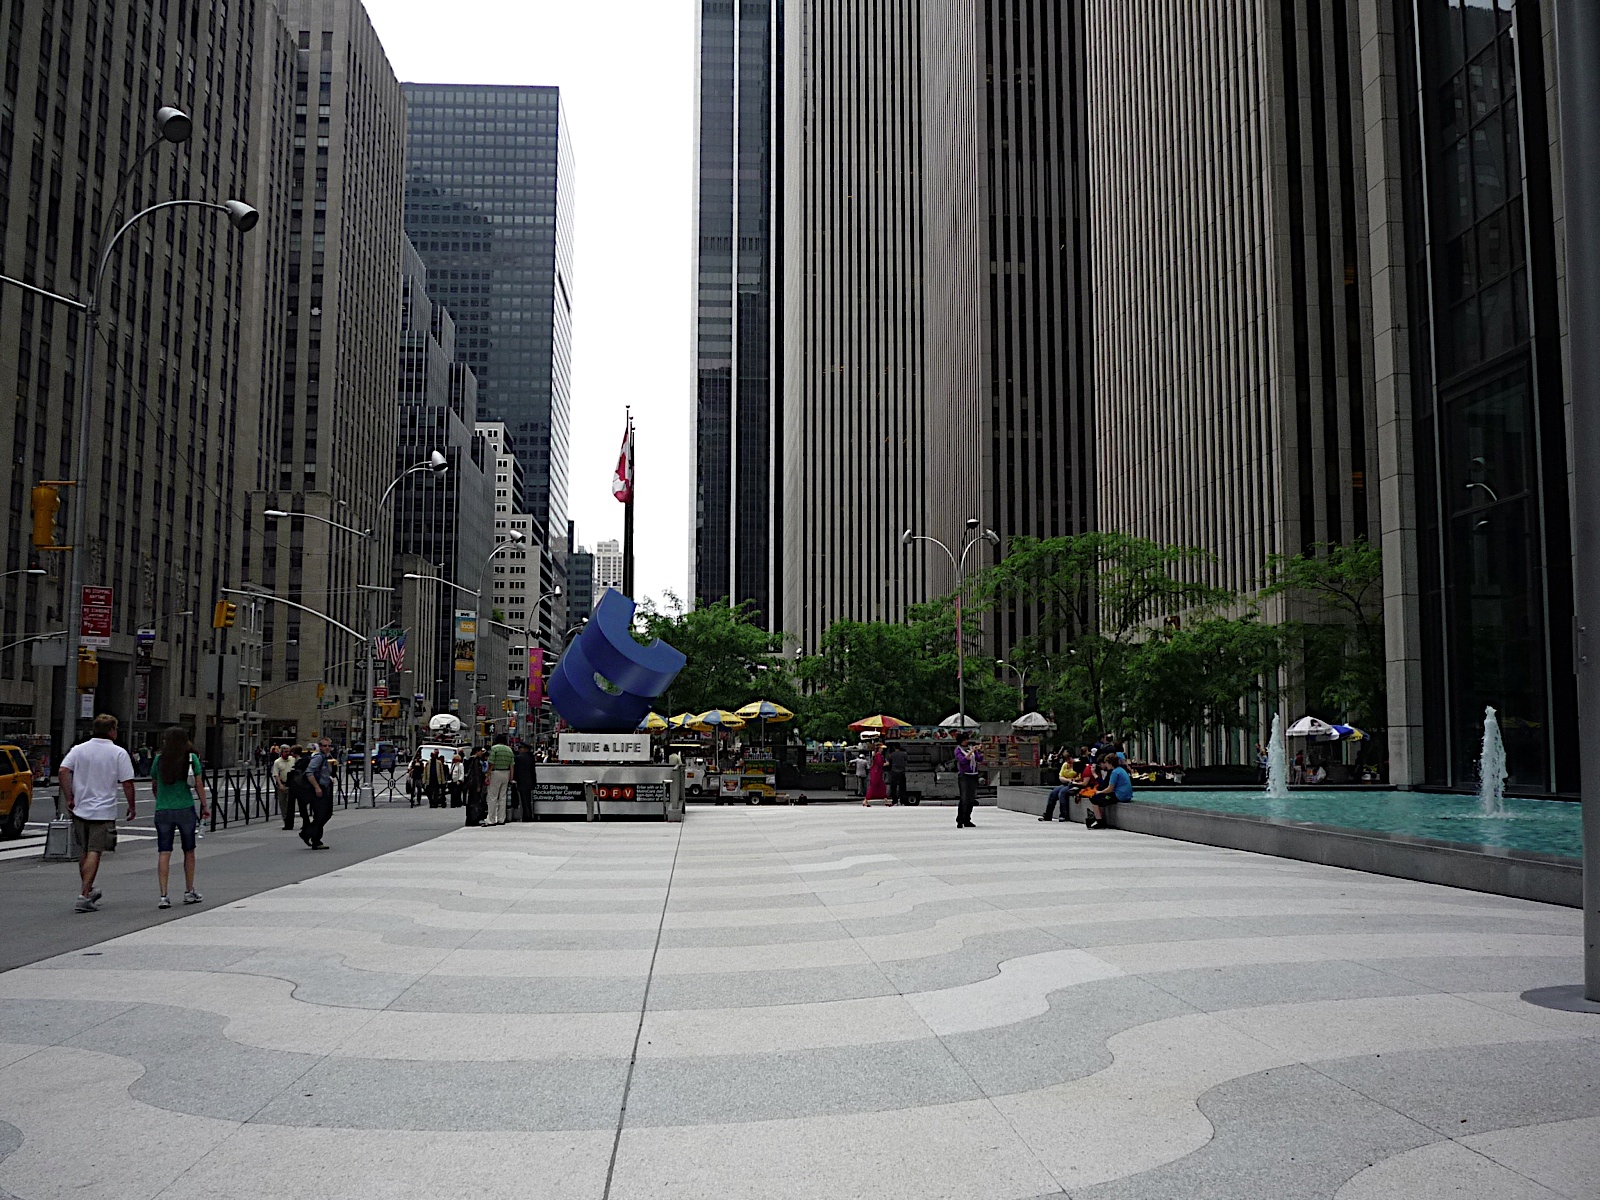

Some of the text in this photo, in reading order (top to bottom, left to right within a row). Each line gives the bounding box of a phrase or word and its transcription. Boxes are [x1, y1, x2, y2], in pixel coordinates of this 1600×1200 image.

[568, 742, 641, 753] TIME & LIFE
[600, 789, 607, 797] D
[612, 789, 619, 797] F
[625, 789, 631, 797] V
